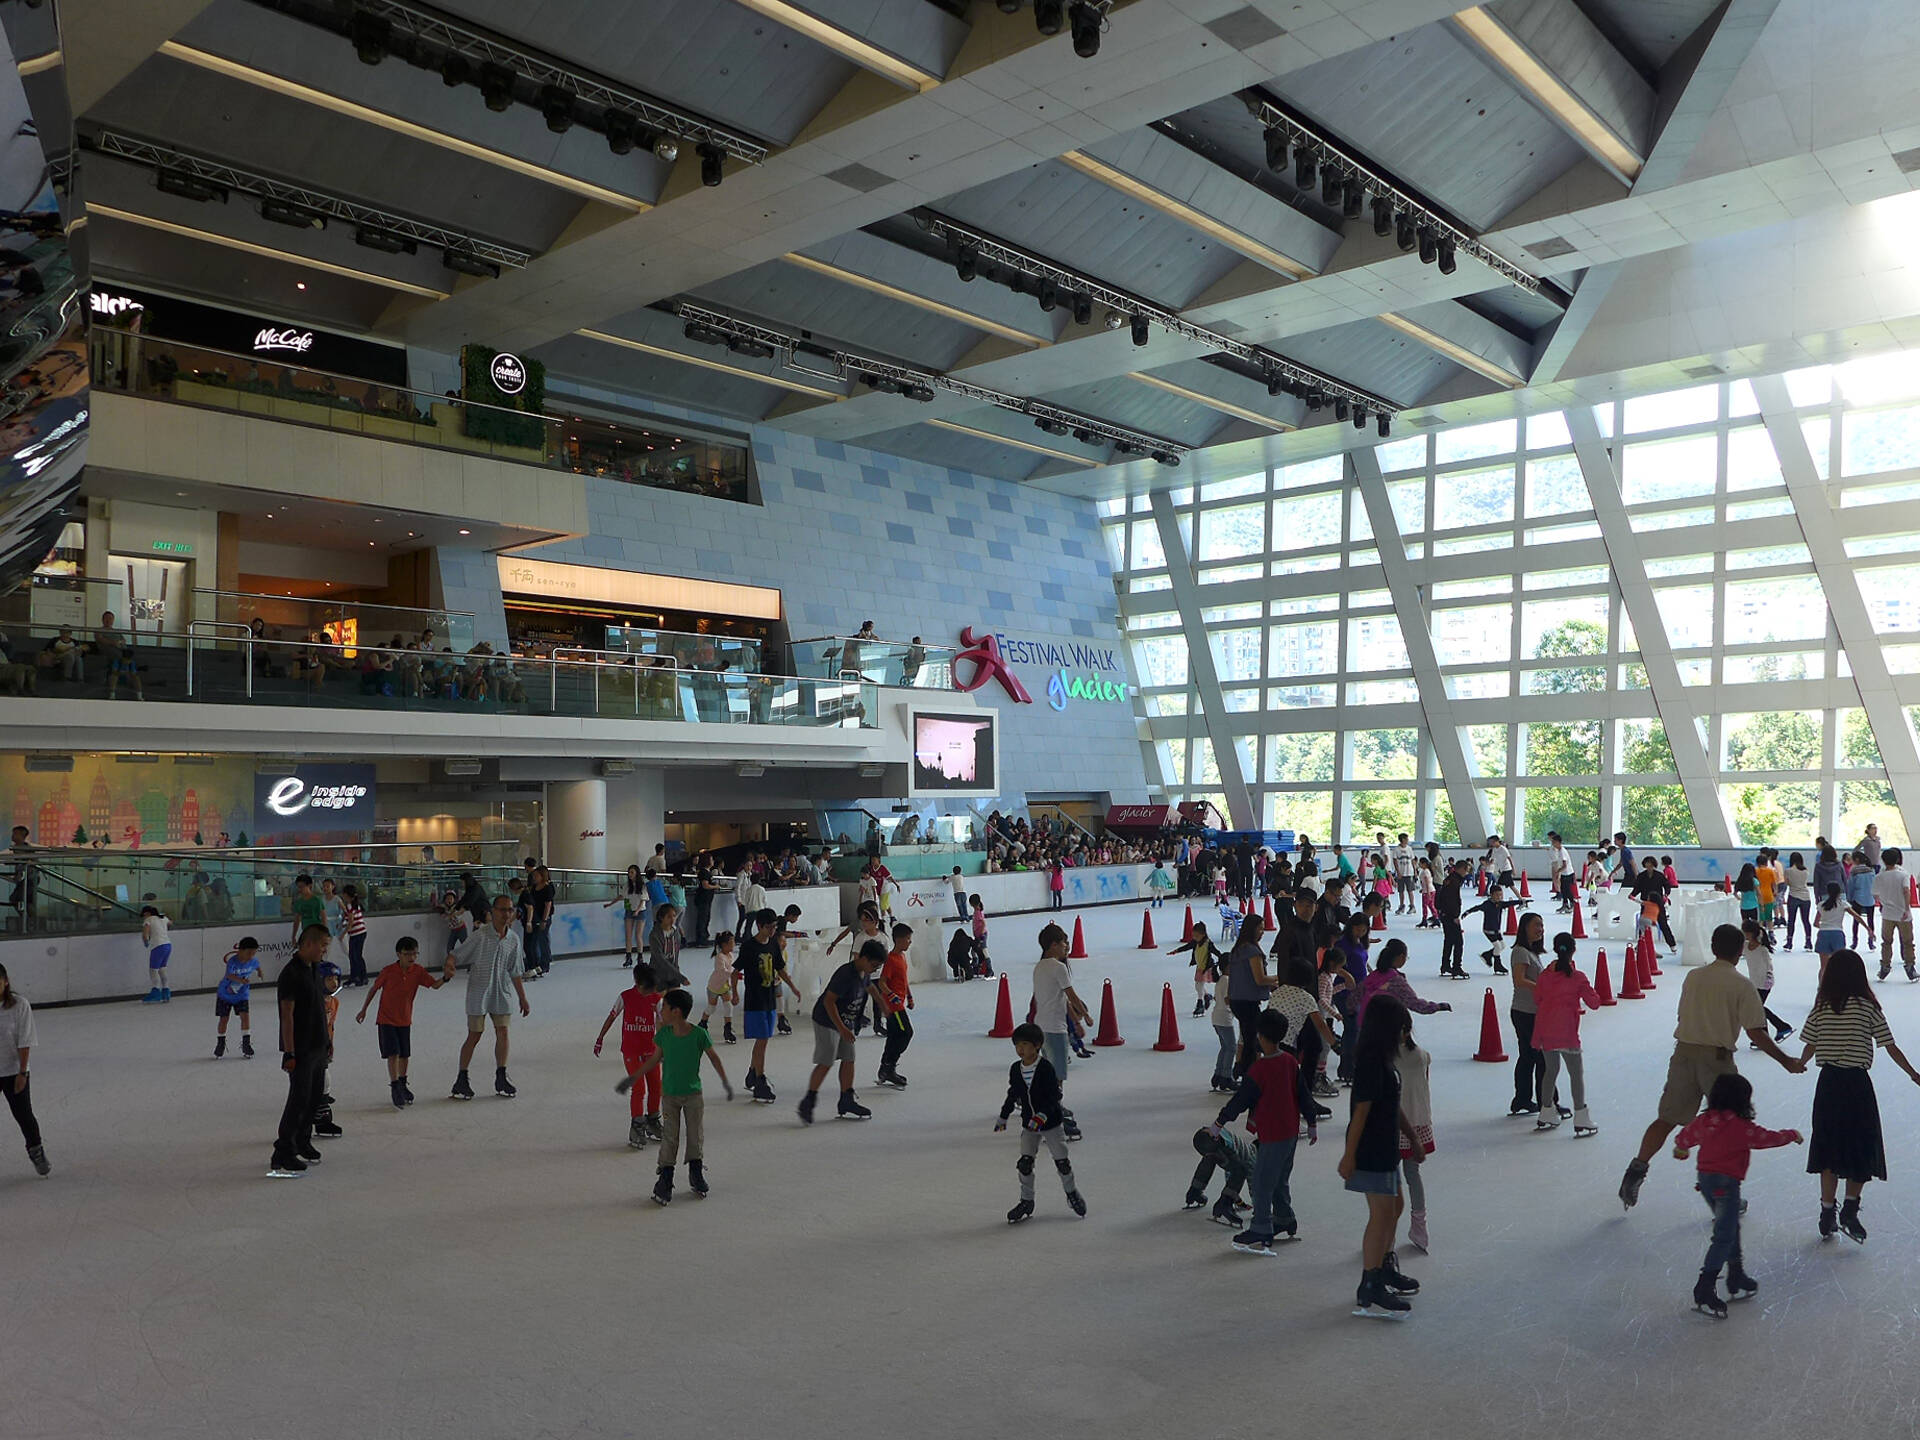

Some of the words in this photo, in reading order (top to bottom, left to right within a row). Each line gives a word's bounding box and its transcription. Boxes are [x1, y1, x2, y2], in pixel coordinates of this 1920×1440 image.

[152, 540, 172, 551] EXIT
[995, 632, 1071, 668] FESTIVAL
[1068, 643, 1118, 672] WALK
[1047, 668, 1128, 712] glacier
[311, 785, 367, 797] inside
[310, 796, 356, 809] edge
[1117, 806, 1156, 823] glacier
[257, 943, 281, 953] STIVAL
